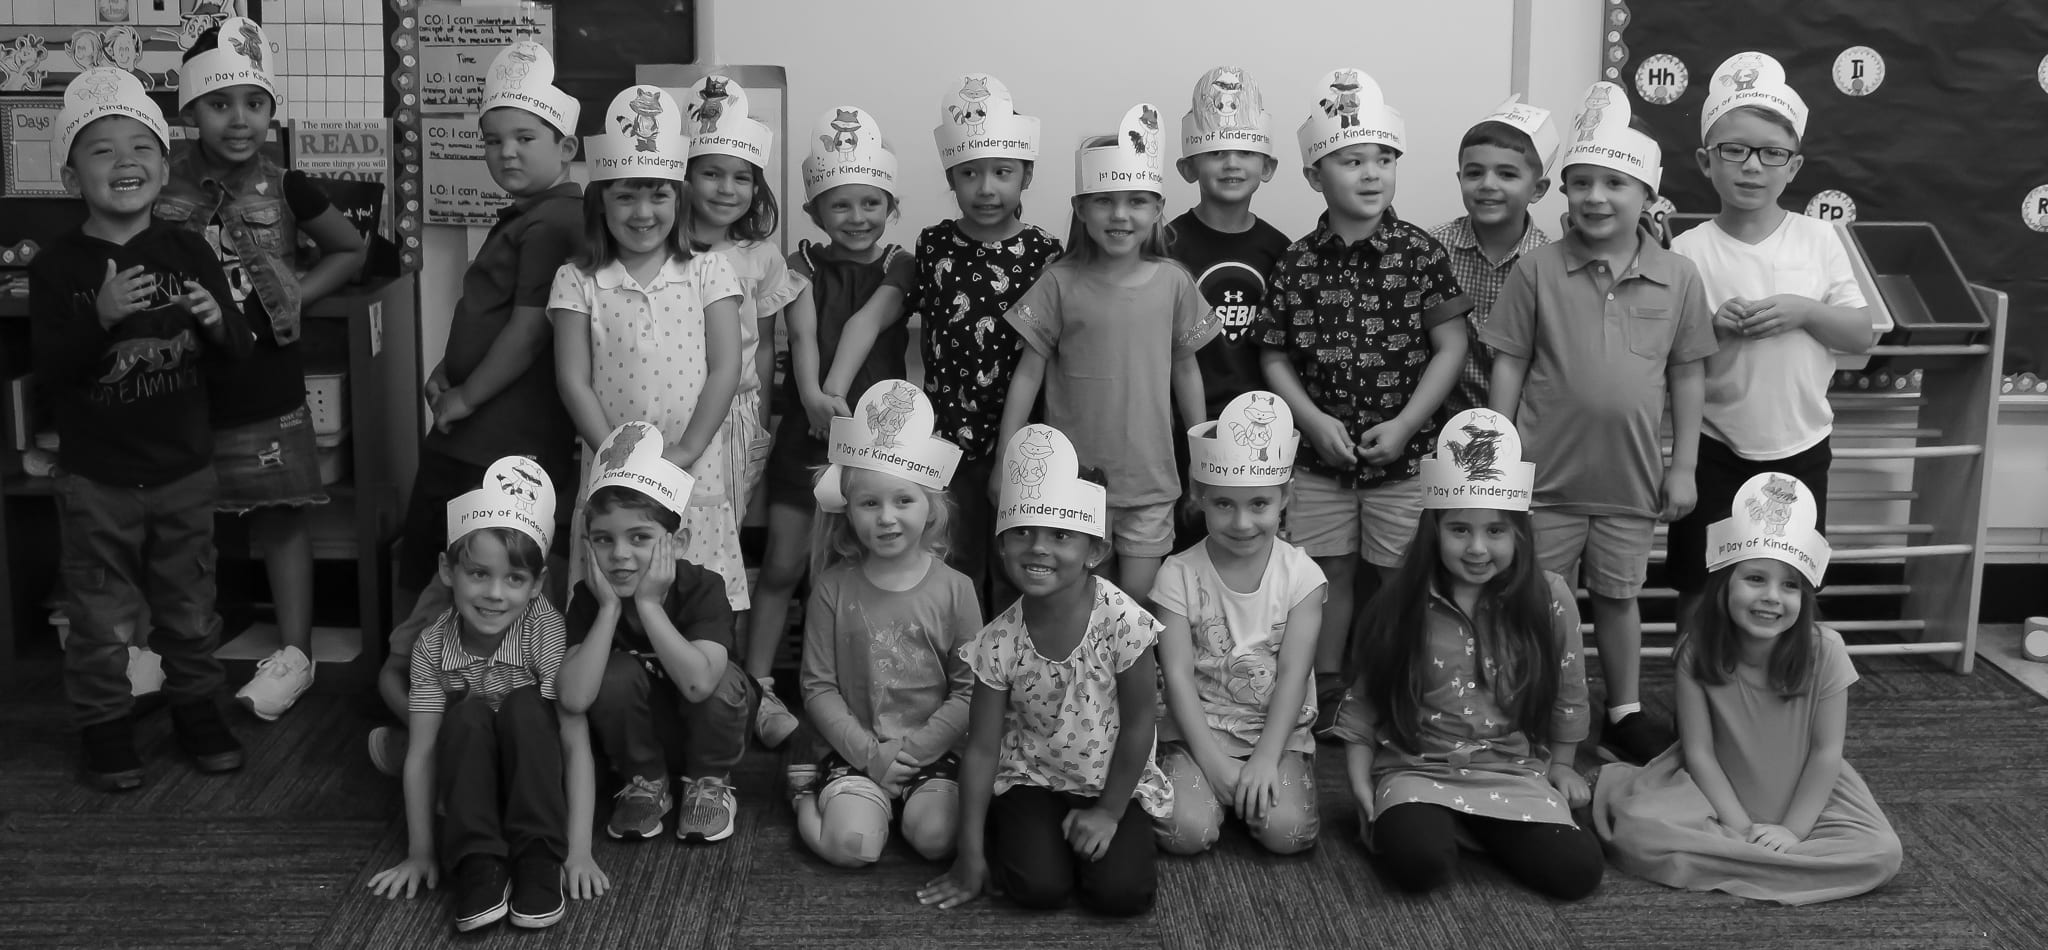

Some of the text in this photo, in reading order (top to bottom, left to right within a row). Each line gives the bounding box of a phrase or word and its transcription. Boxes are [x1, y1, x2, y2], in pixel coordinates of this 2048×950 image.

[424, 15, 535, 25] CO: I can understand the
[458, 26, 477, 34] time
[516, 27, 541, 36] people
[456, 53, 477, 64] Time
[215, 71, 235, 81] Day
[239, 70, 249, 78] of
[427, 72, 445, 83] LO:
[455, 74, 475, 83] can
[1649, 68, 1675, 86] Hh
[1722, 96, 1733, 106] of
[16, 114, 50, 131] Days
[66, 117, 80, 134] Day
[83, 109, 95, 118] of
[302, 120, 379, 132] The more that you
[428, 127, 448, 138] CO:
[458, 131, 478, 139] can
[1190, 135, 1203, 145] Day
[1205, 131, 1216, 141] of
[300, 133, 384, 156] READ,
[957, 142, 966, 152] of
[1313, 140, 1327, 152] Day
[1329, 132, 1340, 143] of
[297, 160, 310, 168] the
[332, 160, 355, 170] things
[356, 161, 371, 170] you
[372, 160, 386, 168] will
[602, 157, 618, 168] Day
[621, 156, 633, 165] of
[826, 168, 836, 178] of
[1099, 171, 1108, 182] 1st
[1111, 170, 1132, 182] Day
[1135, 170, 1146, 180] of
[429, 184, 448, 195] LO:
[458, 187, 478, 196] can
[1820, 203, 1843, 220] Pp
[842, 443, 857, 457] Day
[859, 448, 870, 457] of
[1209, 463, 1229, 476] Day
[1232, 465, 1246, 475] of
[1433, 486, 1449, 498] Day
[1453, 485, 1466, 495] of
[472, 509, 494, 519] Day
[498, 509, 512, 518] of
[1008, 505, 1017, 517] of
[1726, 542, 1743, 553] Day
[1746, 538, 1759, 548] of
